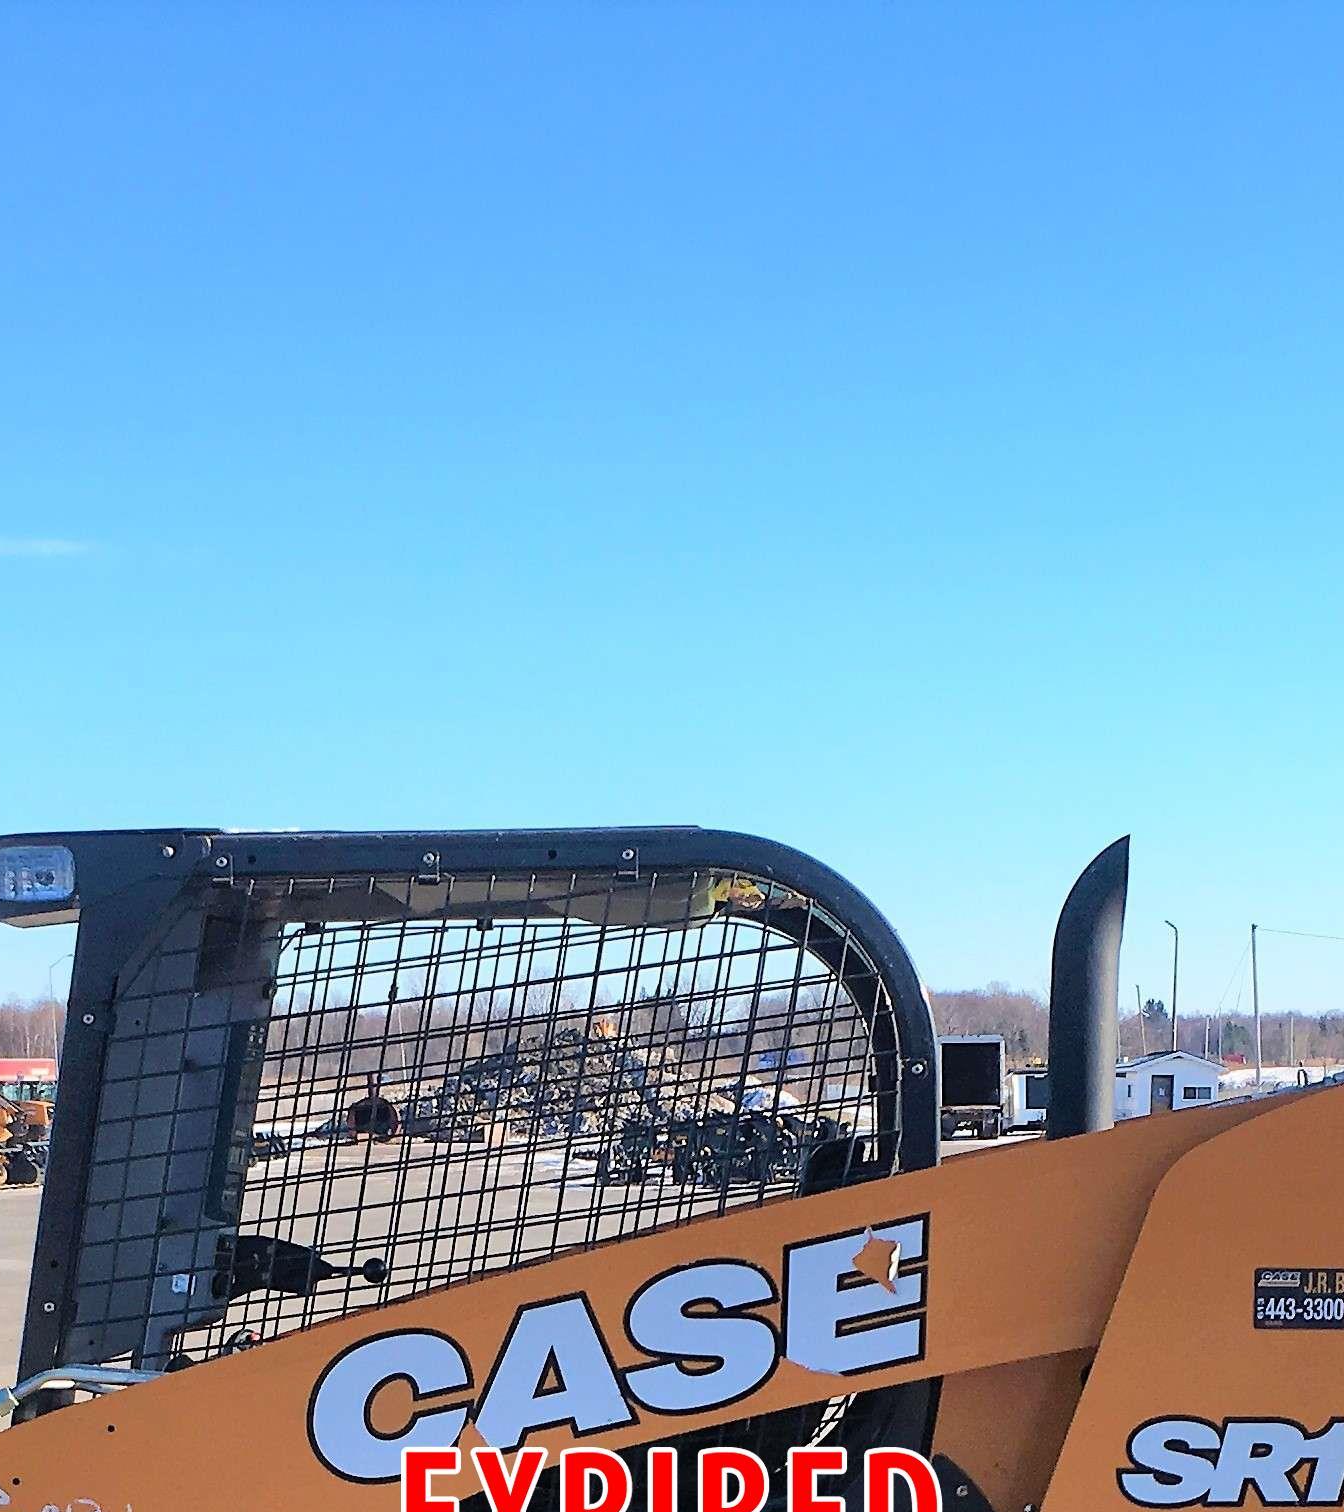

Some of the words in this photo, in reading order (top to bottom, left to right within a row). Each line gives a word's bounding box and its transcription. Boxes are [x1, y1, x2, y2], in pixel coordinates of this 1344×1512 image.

[1304, 1272, 1332, 1294] J.R.
[1265, 1298, 1344, 1321] 443-3300
[307, 1211, 930, 1486] CASE
